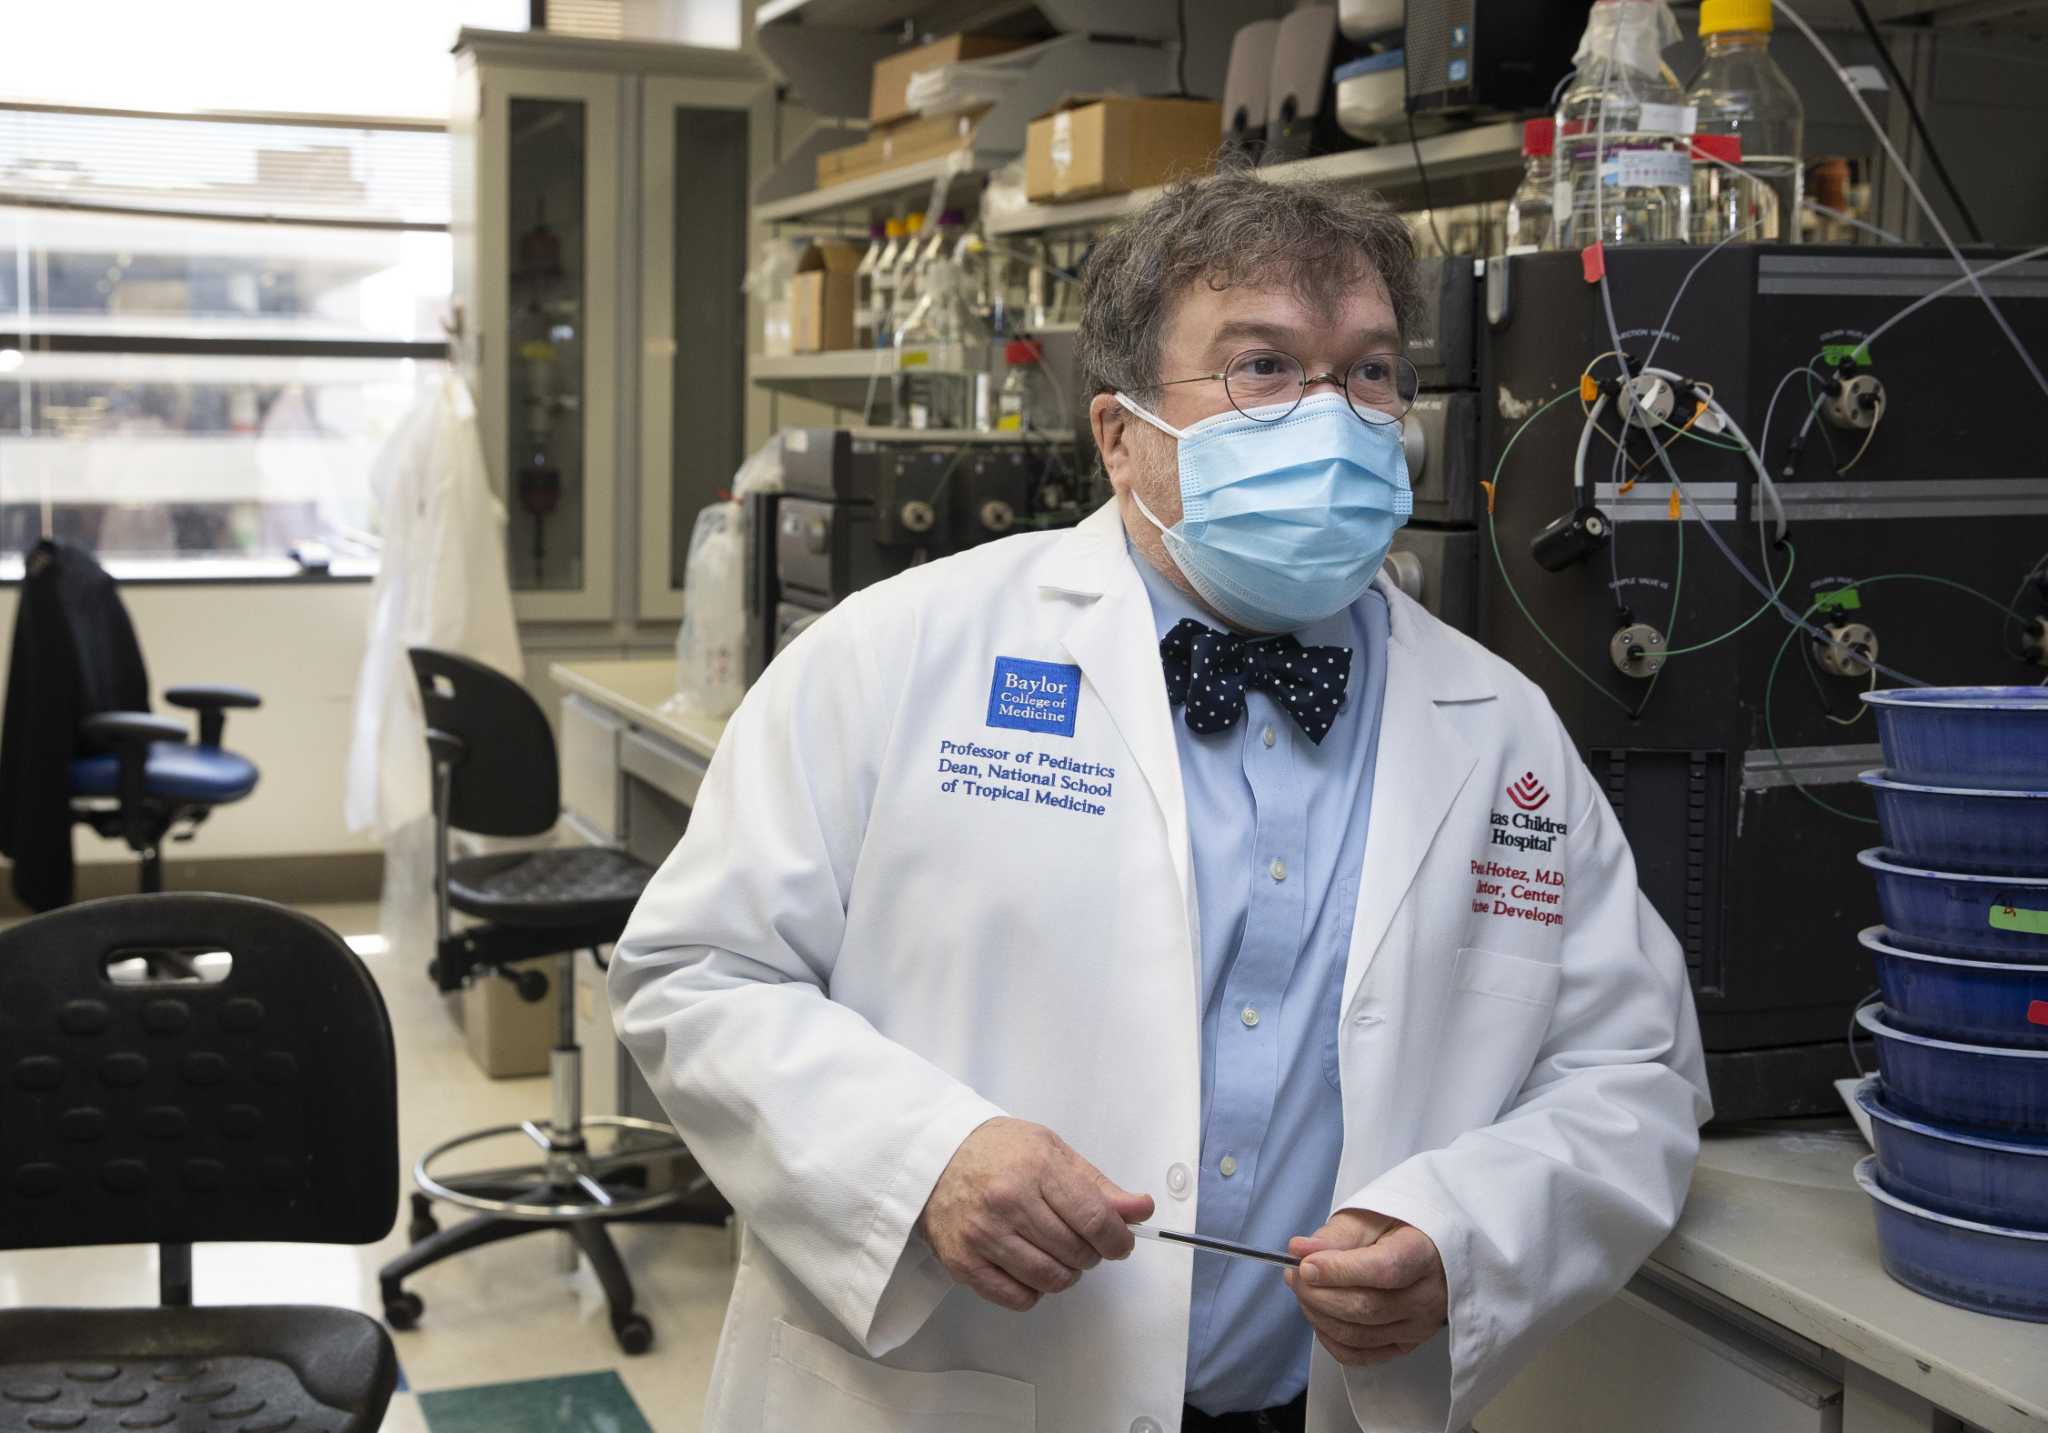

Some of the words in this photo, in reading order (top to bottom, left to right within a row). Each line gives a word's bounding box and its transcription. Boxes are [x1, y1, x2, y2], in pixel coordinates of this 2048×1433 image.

[1005, 672, 1067, 694] Baylor
[1001, 692, 1051, 709] College
[1052, 698, 1067, 709] of
[999, 704, 1065, 722] Medicine
[940, 740, 1010, 760] Professor
[1015, 751, 1034, 764] of
[1038, 753, 1115, 778] Pediatrics
[937, 758, 982, 779] Dean,
[988, 764, 1056, 787] National
[1060, 775, 1112, 797] School
[941, 779, 960, 793] of
[963, 780, 1030, 802] Tropical
[1034, 789, 1105, 816] Medicine
[1487, 861, 1530, 883] Hotez,
[1511, 884, 1560, 904] Center
